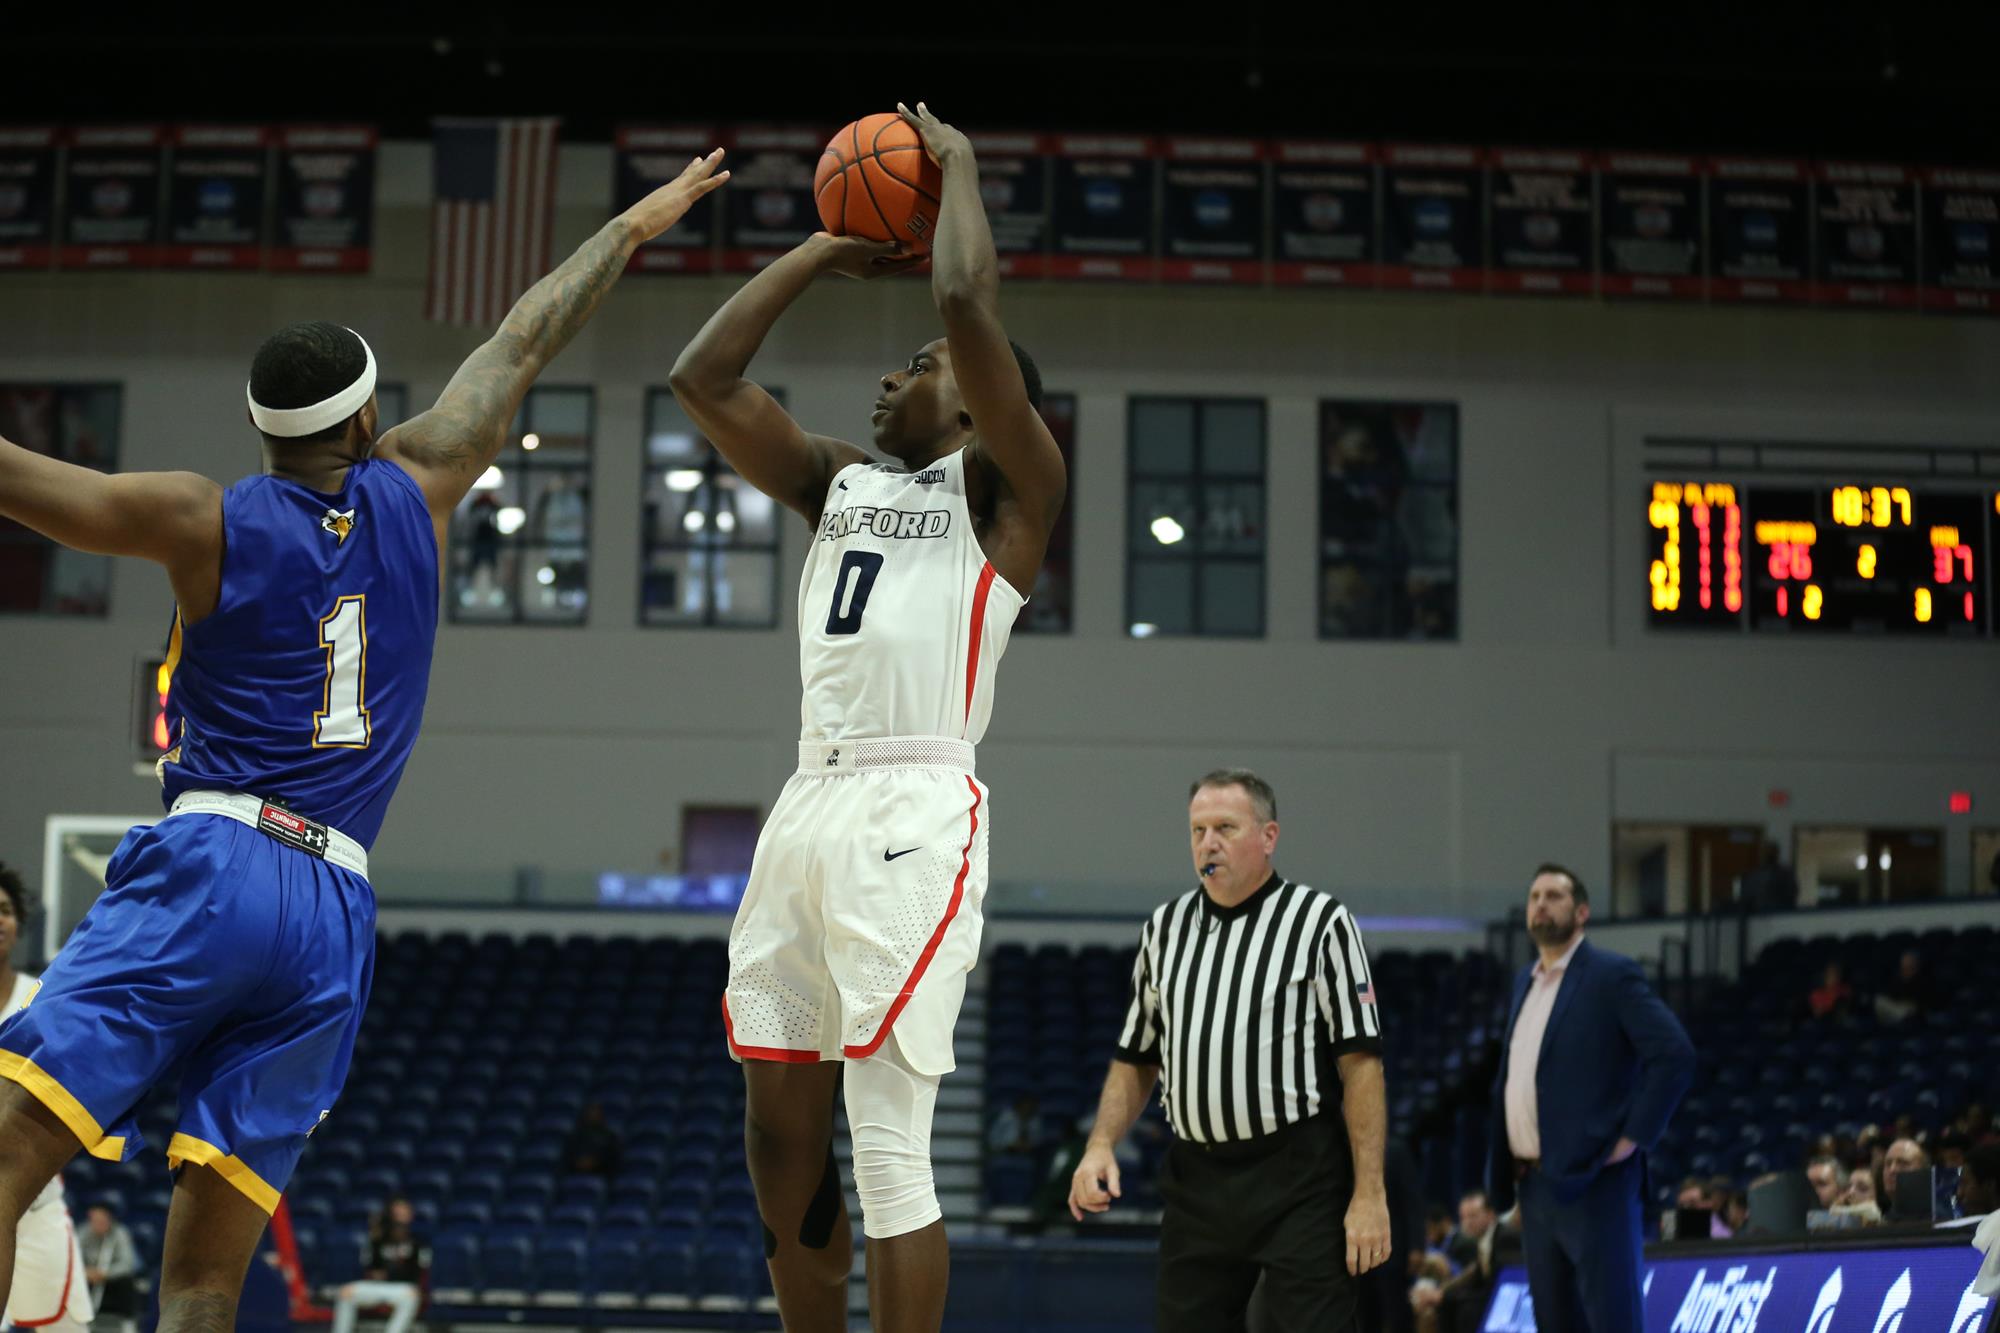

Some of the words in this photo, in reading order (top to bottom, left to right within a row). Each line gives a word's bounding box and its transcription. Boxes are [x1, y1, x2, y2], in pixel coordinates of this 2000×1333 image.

[820, 506, 951, 541] AMFORD
[825, 550, 884, 635] 0
[312, 594, 371, 749] 1
[270, 811, 300, 829] AUTHENTIC
[1669, 1264, 1778, 1333] AmFirst
